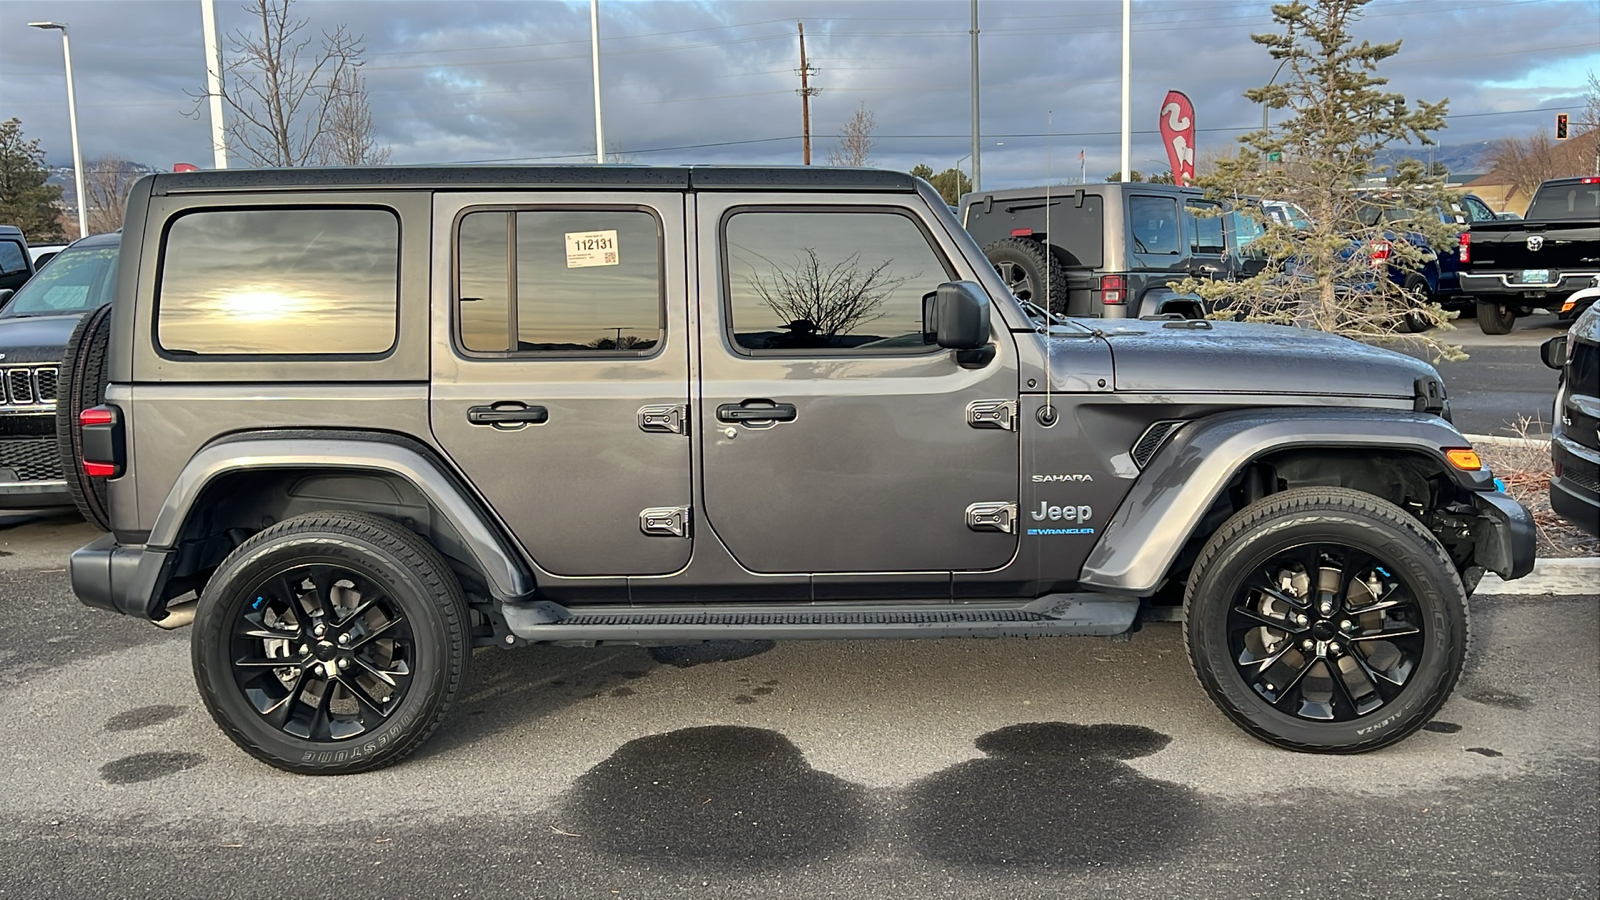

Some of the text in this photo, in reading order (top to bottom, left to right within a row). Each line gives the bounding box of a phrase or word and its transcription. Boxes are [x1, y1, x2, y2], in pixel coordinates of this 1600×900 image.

[575, 238, 612, 251] 112131
[1031, 474, 1093, 482] SAHARA
[1031, 501, 1092, 524] Jeep
[1357, 710, 1402, 735] ALENZA
